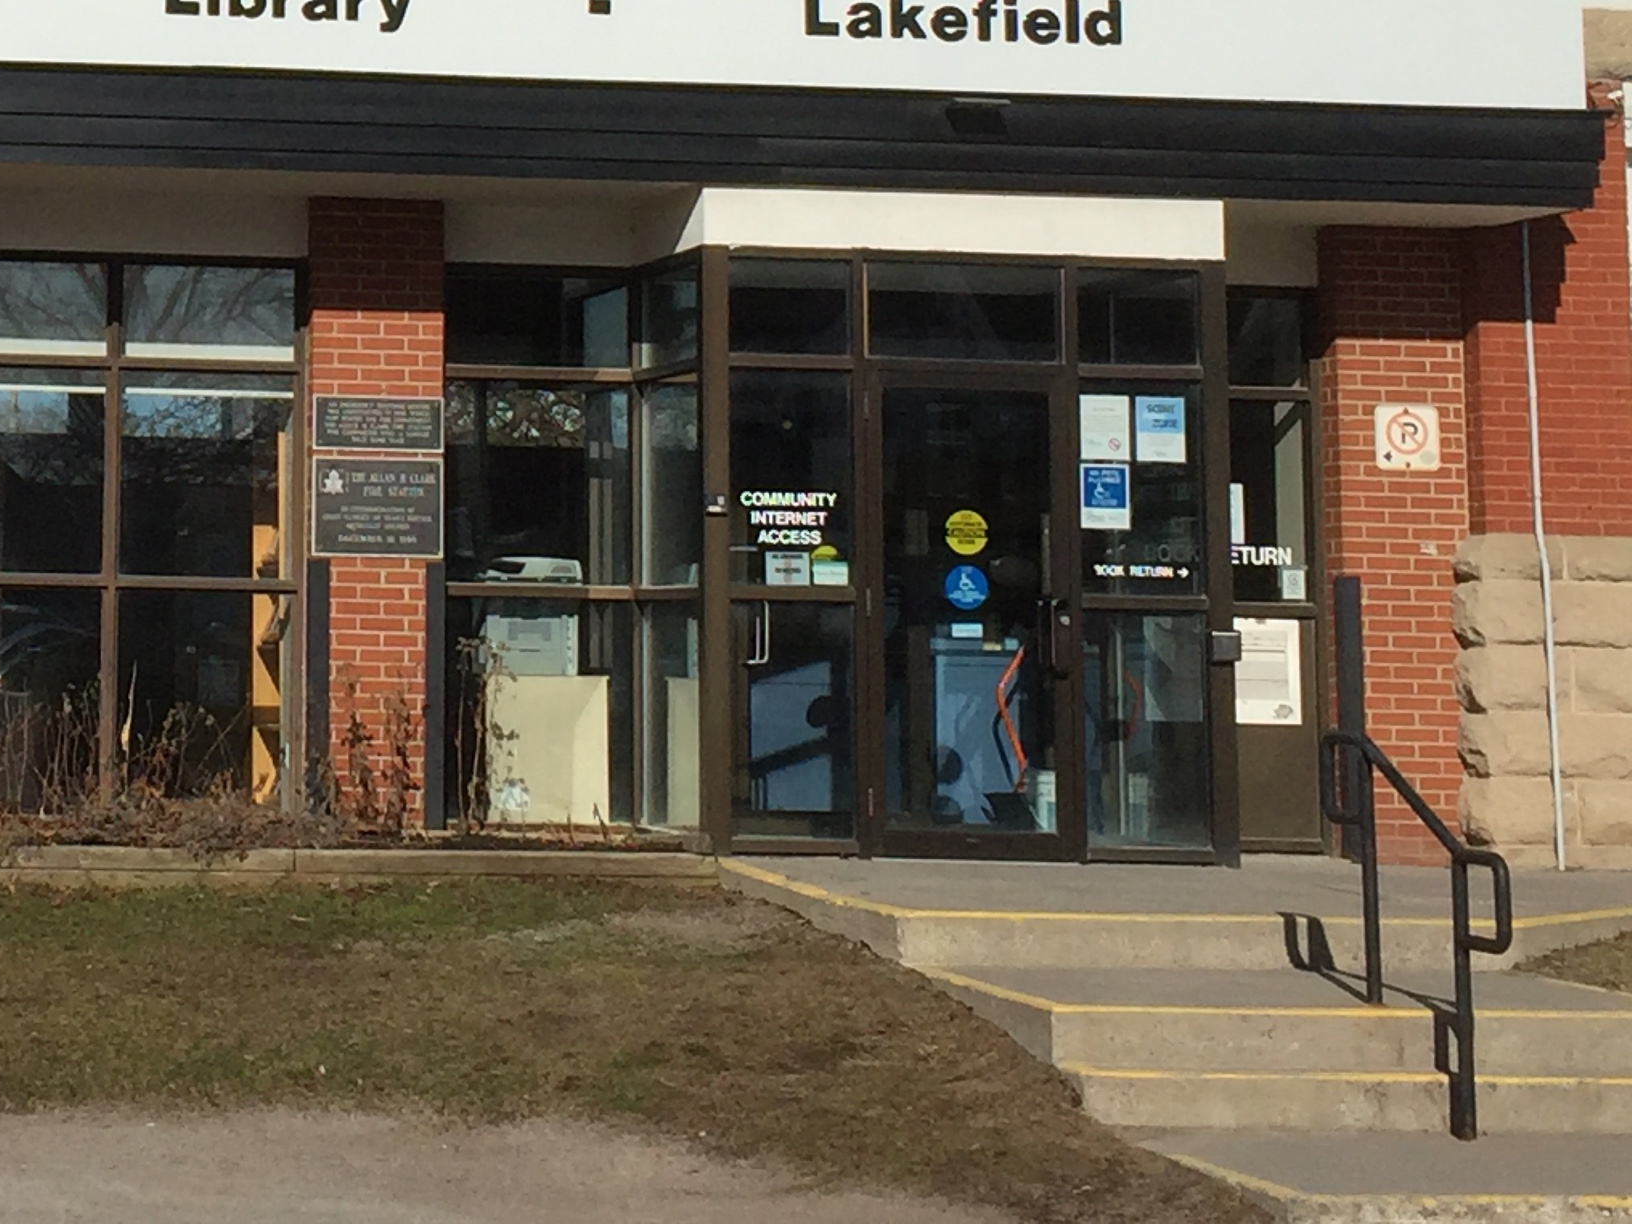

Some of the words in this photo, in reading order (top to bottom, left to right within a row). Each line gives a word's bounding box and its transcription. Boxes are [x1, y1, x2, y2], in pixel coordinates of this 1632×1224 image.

[740, 491, 837, 507] COMMUNITY
[750, 510, 828, 526] INTERNET
[757, 529, 822, 545] ACCESS
[1231, 545, 1292, 566] ETURN
[1129, 565, 1174, 578] RETURN
